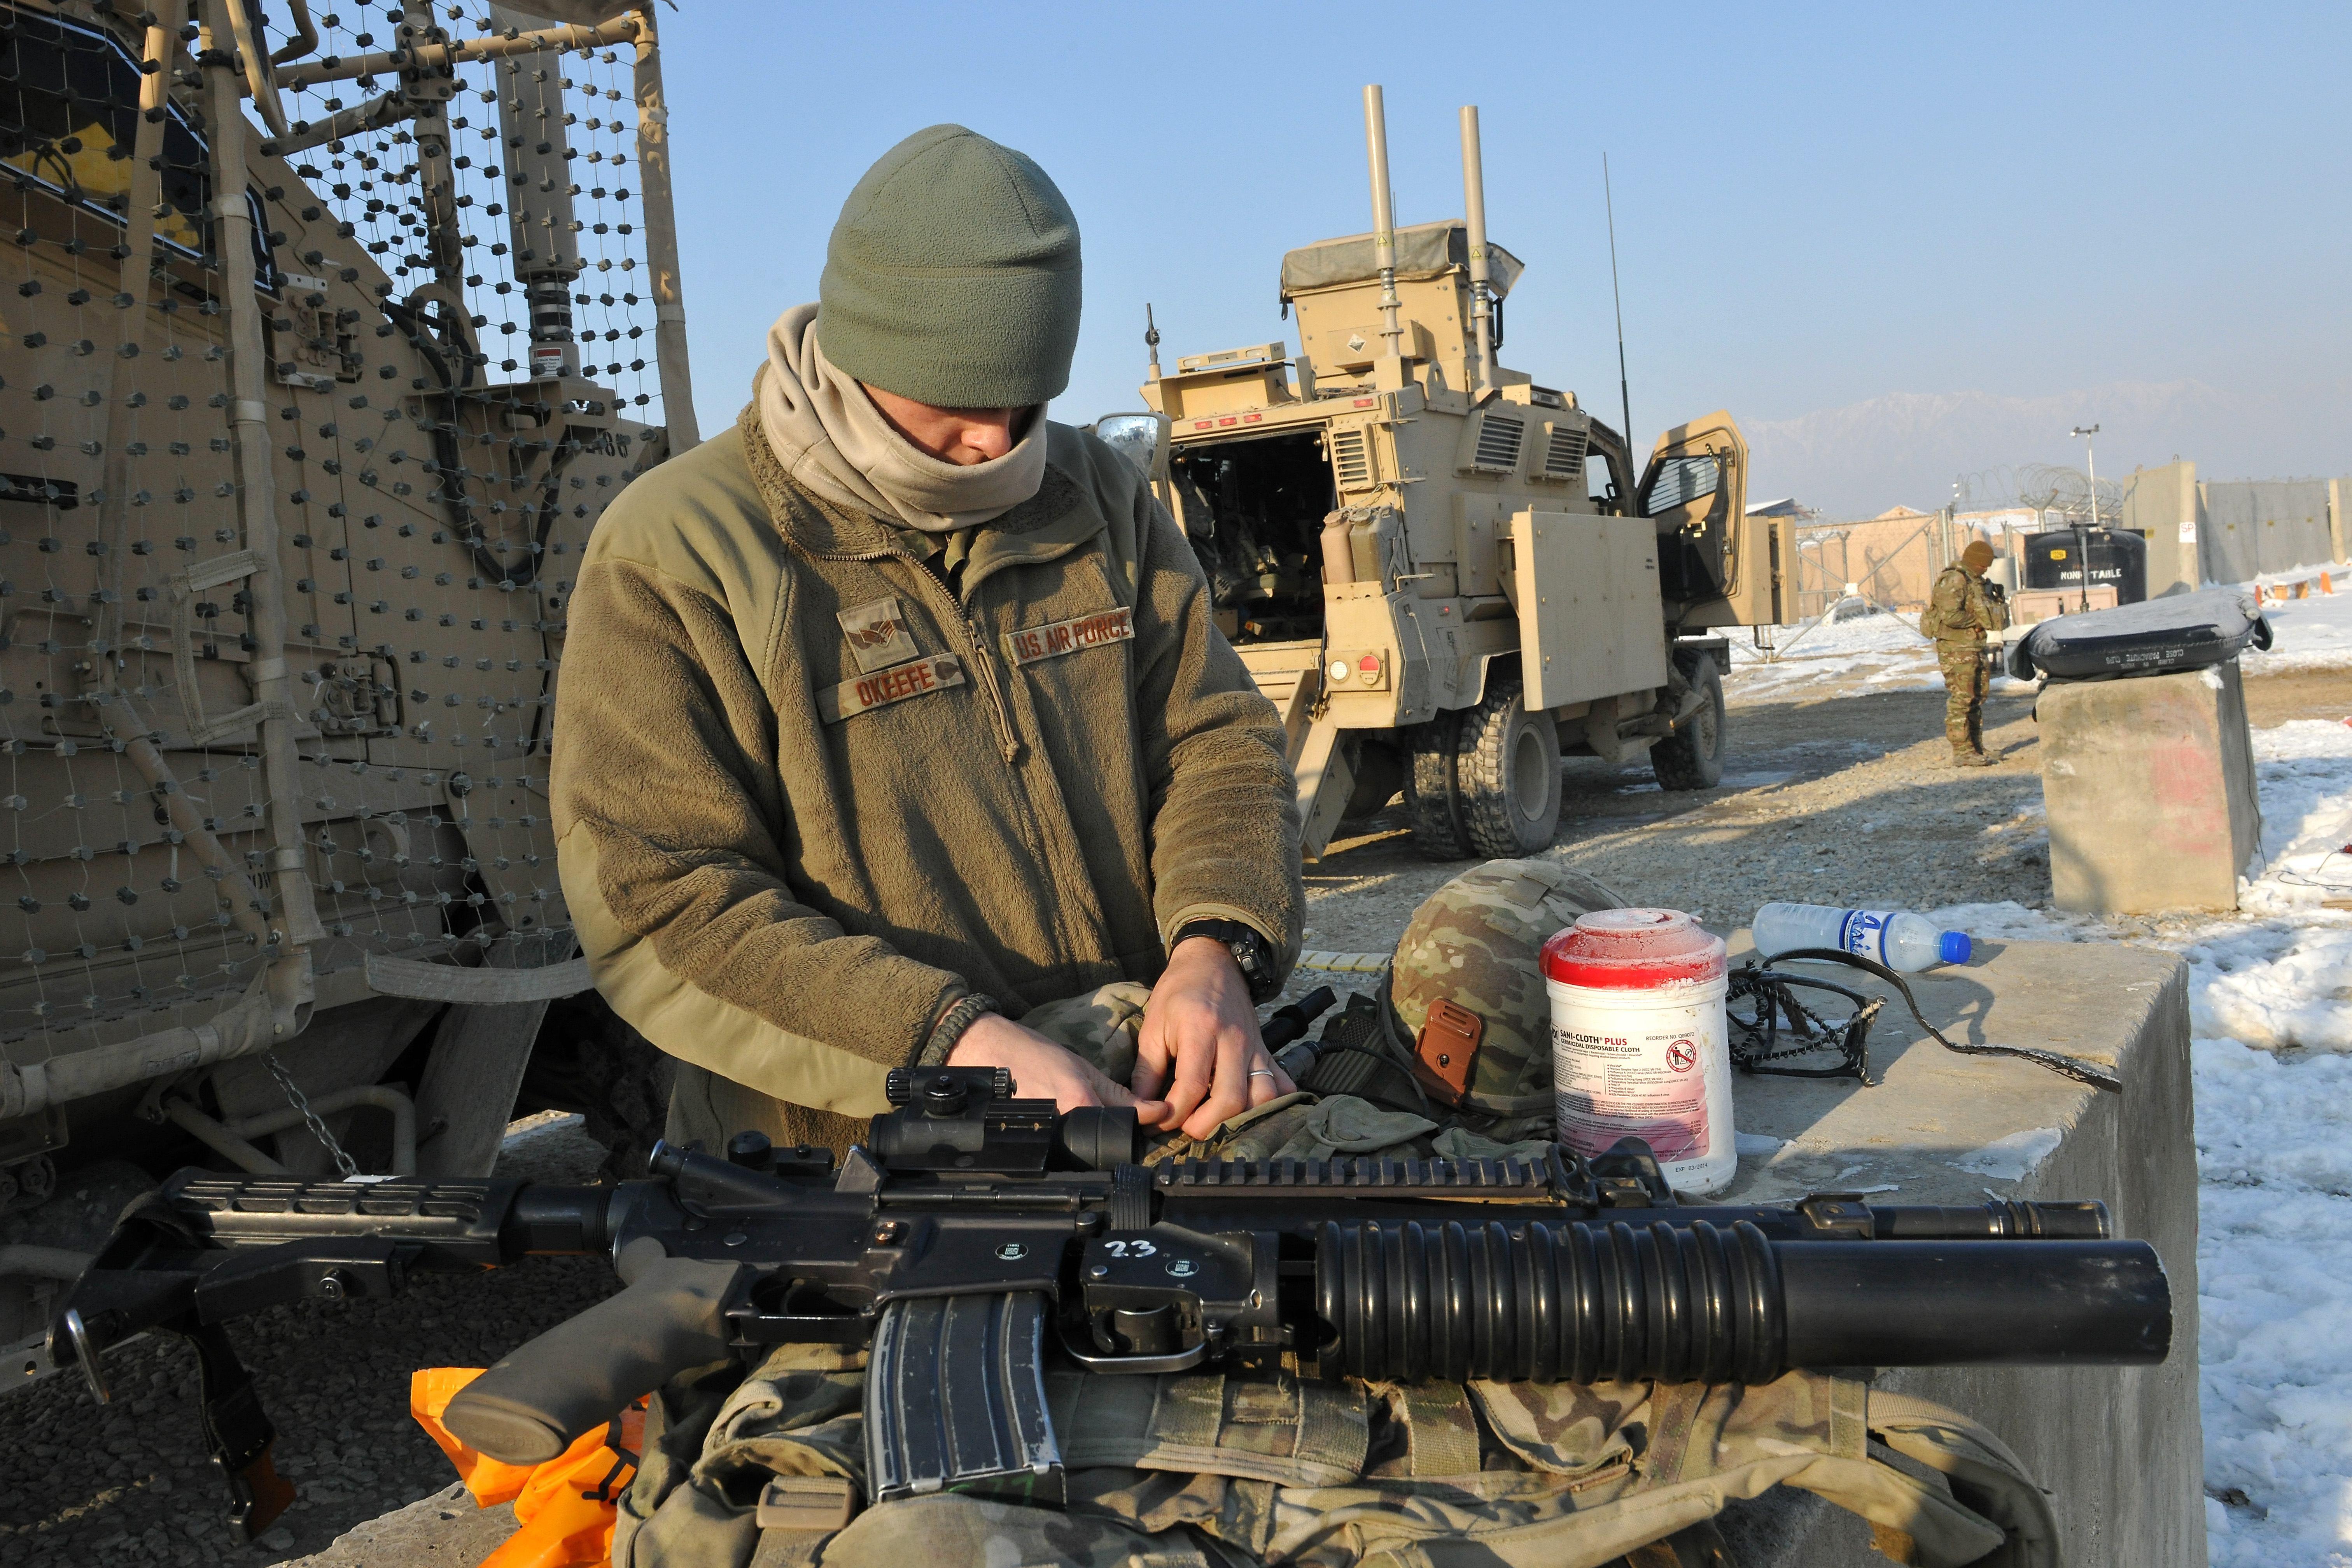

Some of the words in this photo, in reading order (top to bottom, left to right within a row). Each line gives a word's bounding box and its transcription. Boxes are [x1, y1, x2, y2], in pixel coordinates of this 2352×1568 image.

[2181, 524, 2194, 533] SP
[2061, 568, 2122, 580] NONTABLE
[1045, 626, 1073, 653] AIR
[1073, 612, 1130, 646] FORCE
[2166, 649, 2184, 658] CLOSE
[856, 663, 934, 707] OKEEFE
[1561, 1038, 1585, 1049] GERMICIDAL
[1586, 1044, 1619, 1052] DISPOSABLE
[1605, 1038, 1627, 1046] PLUS
[1104, 1240, 1157, 1257] 23
